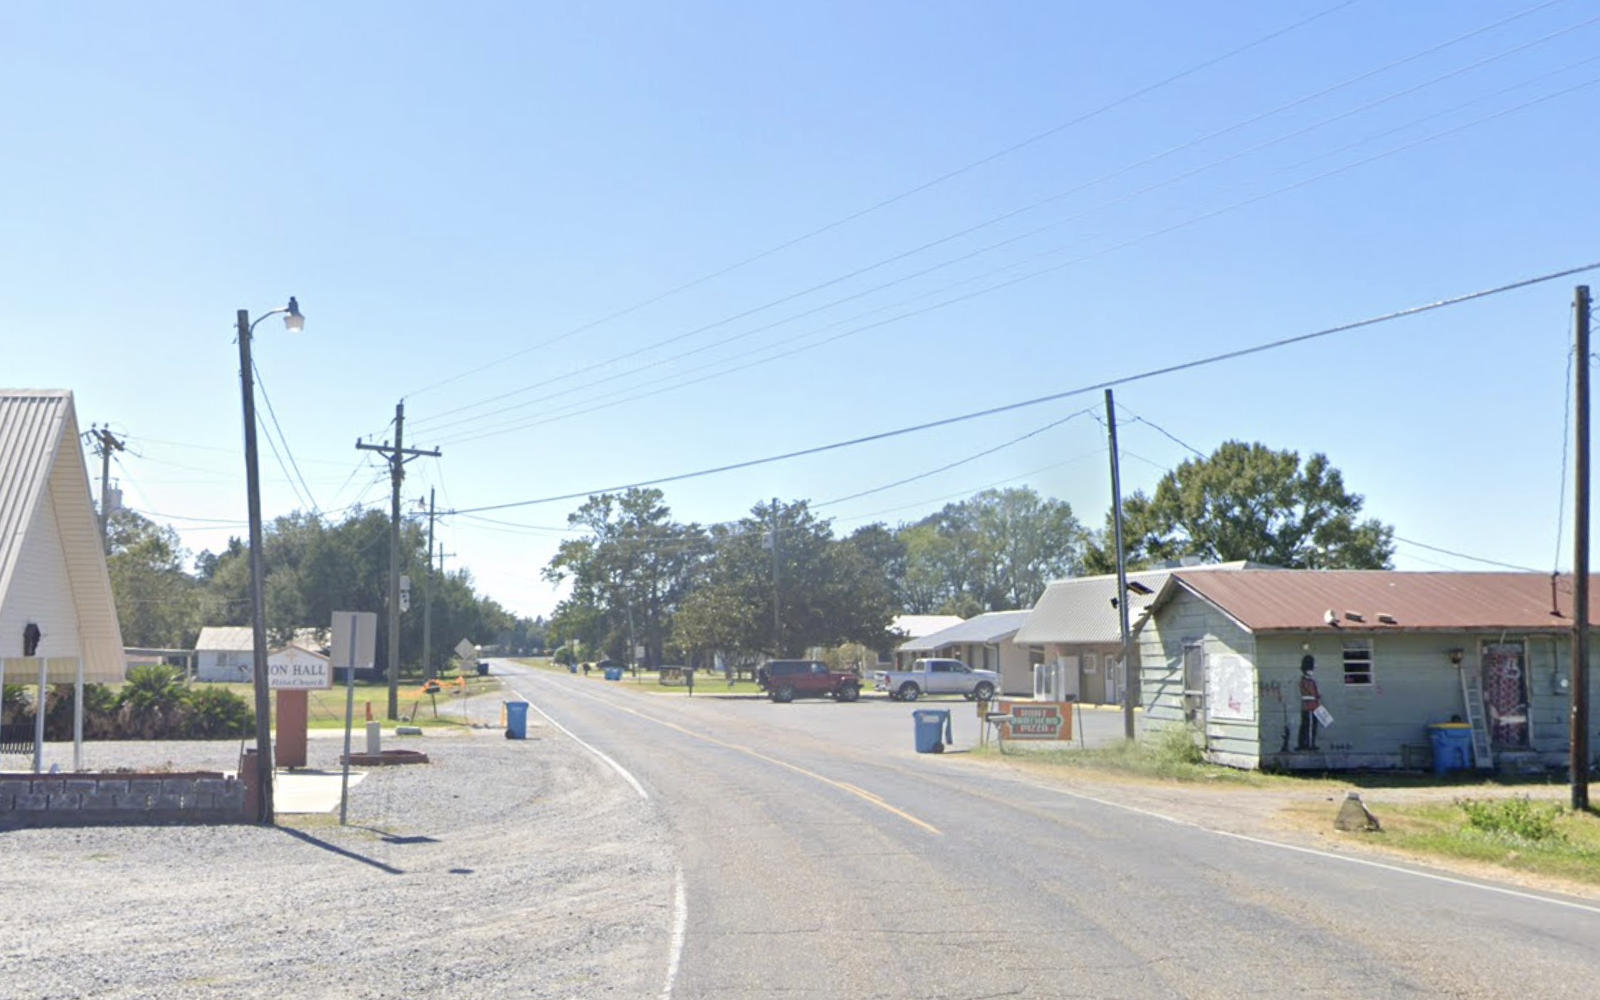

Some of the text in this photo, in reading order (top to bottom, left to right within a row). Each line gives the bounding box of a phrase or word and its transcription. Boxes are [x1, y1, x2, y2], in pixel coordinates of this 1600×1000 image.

[293, 664, 326, 675] HALL
[292, 677, 324, 686] Church
[1020, 725, 1047, 733] PIZZA
